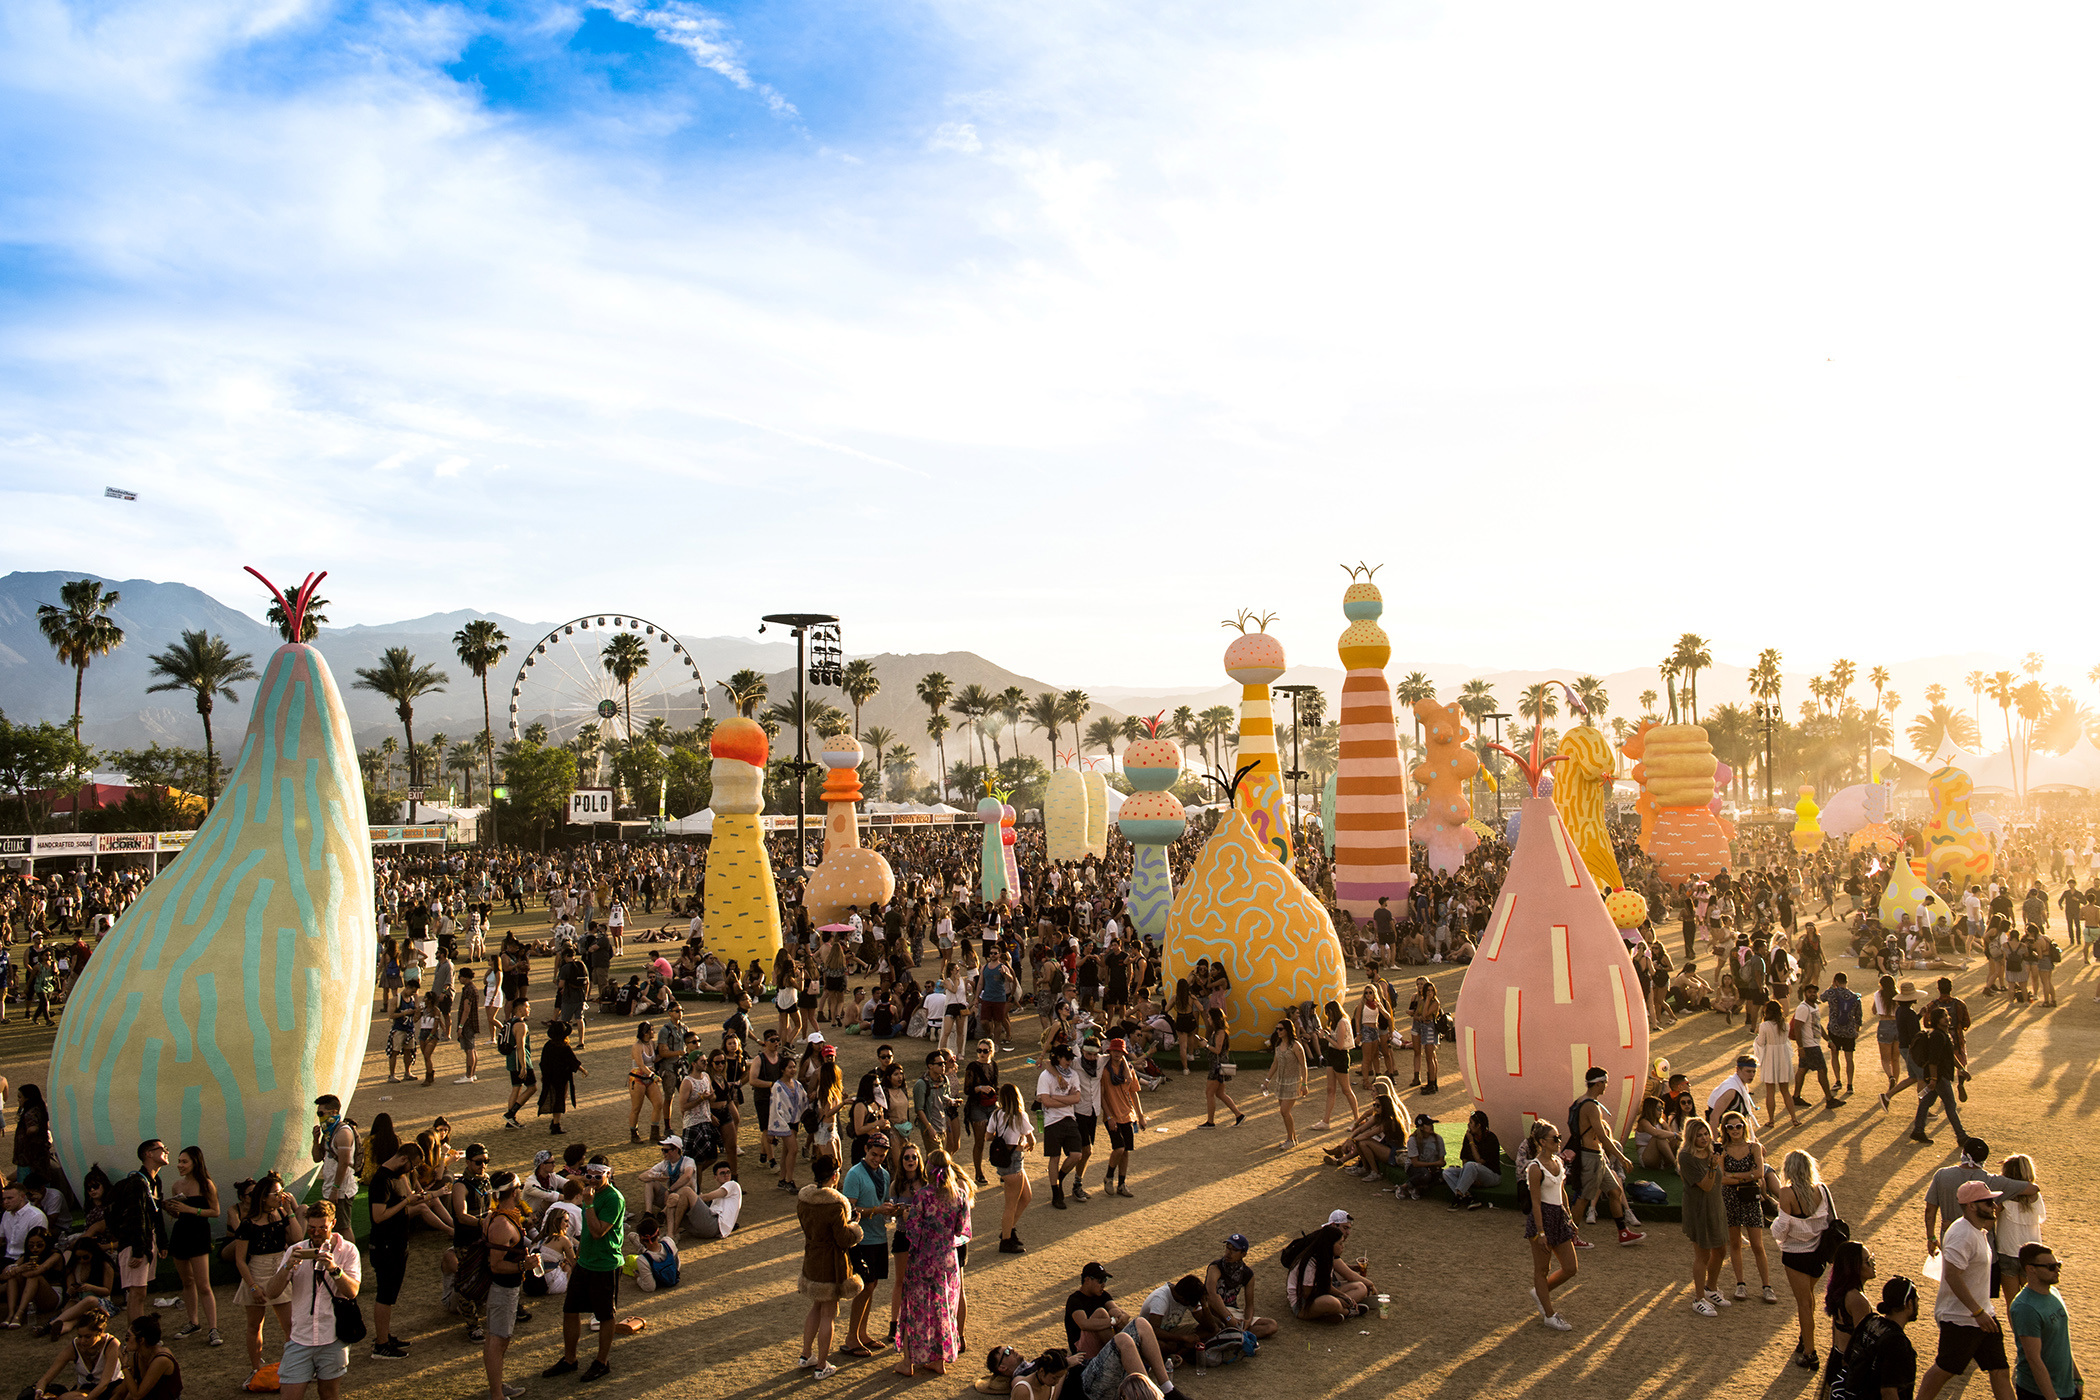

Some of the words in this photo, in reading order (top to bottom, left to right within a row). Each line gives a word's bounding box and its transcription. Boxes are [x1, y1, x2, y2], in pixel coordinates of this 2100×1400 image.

[408, 791, 424, 800] EXIT
[574, 795, 607, 812] POLO
[112, 841, 141, 849] CORN
